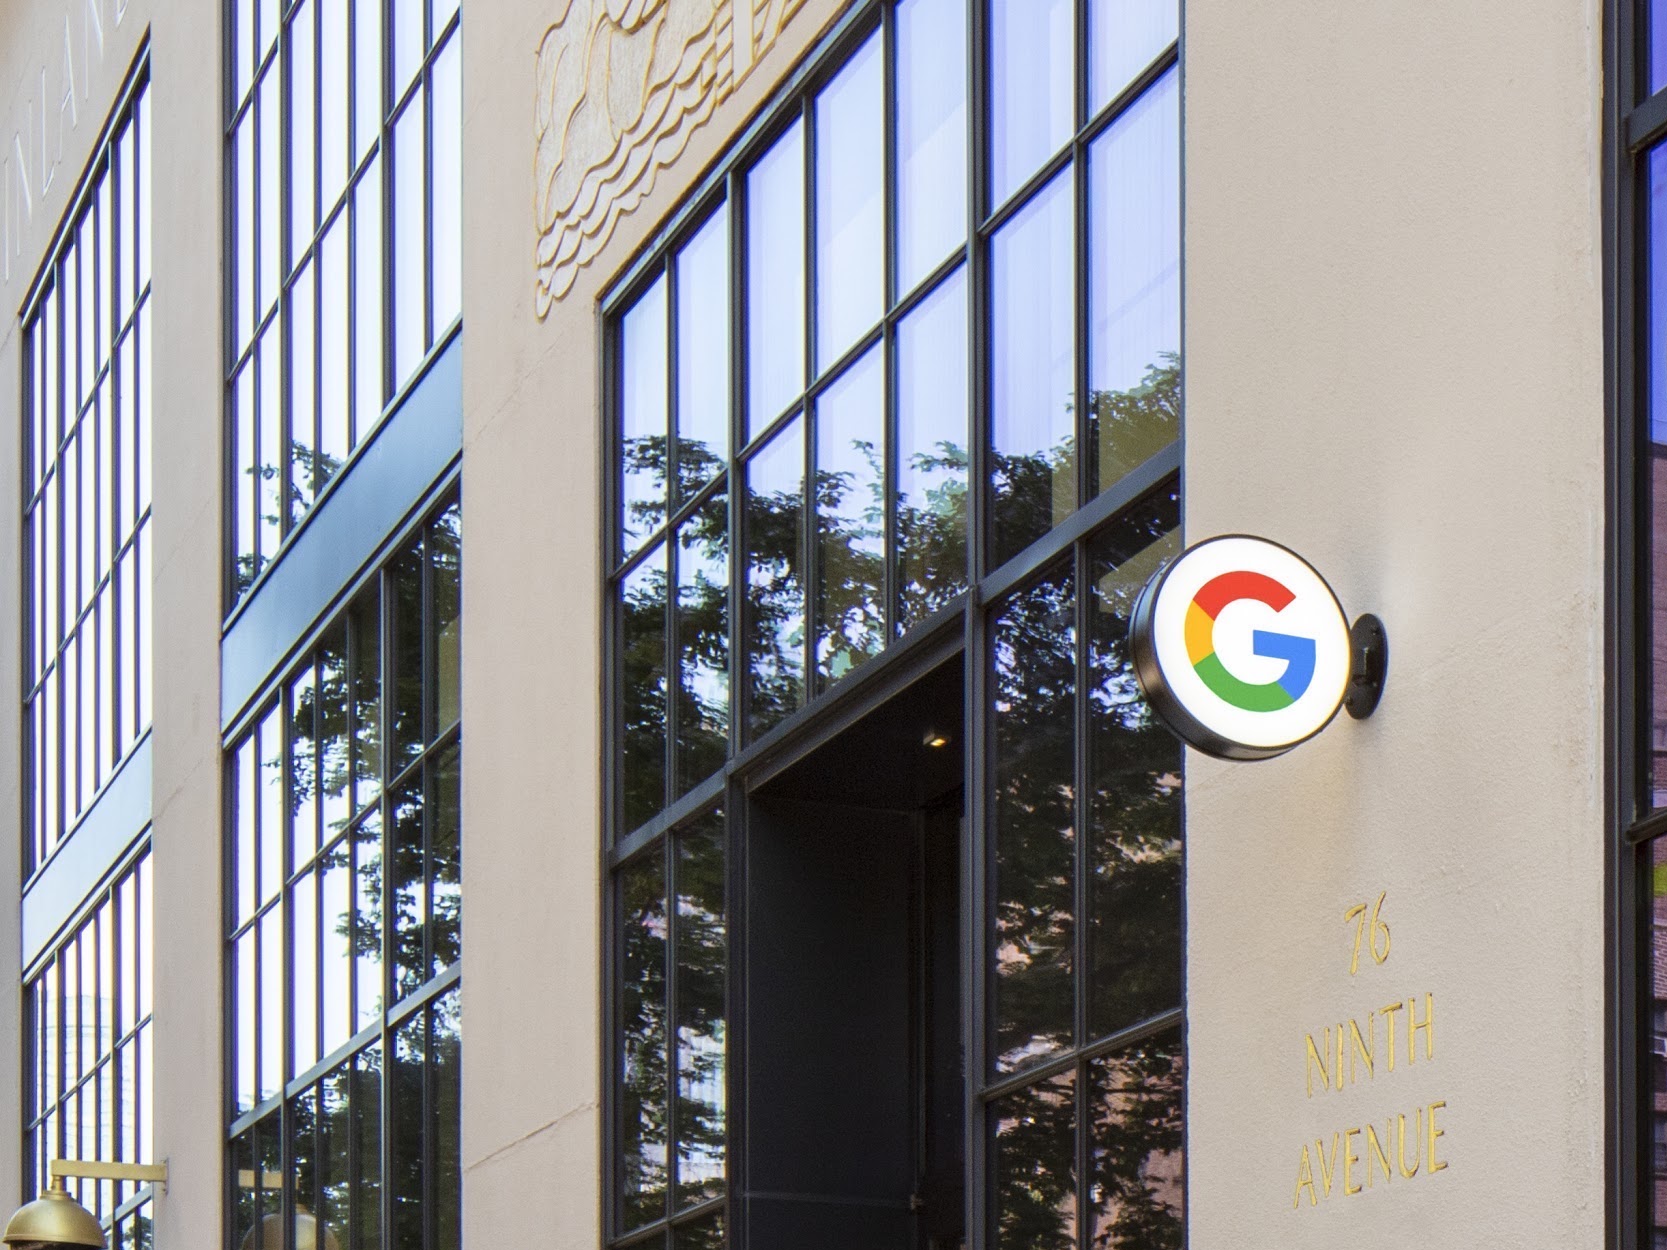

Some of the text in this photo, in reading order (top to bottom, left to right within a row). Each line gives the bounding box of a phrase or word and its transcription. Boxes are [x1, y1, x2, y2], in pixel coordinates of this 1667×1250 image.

[4, 0, 129, 285] INLAN
[1184, 570, 1317, 713] G
[1344, 890, 1391, 976] 76
[1305, 991, 1433, 1099] NINTH
[1293, 1100, 1448, 1209] AVENUE
